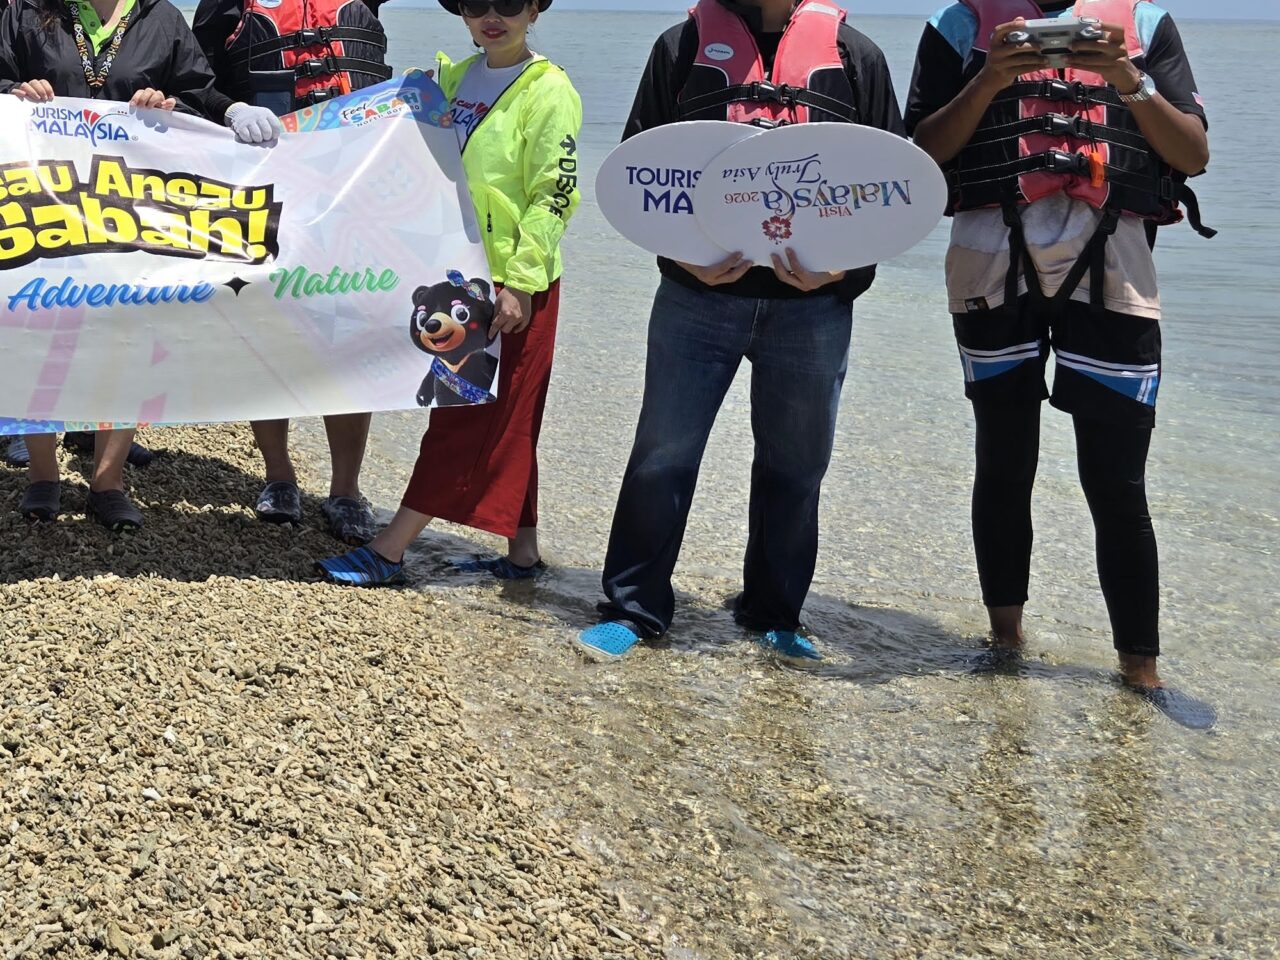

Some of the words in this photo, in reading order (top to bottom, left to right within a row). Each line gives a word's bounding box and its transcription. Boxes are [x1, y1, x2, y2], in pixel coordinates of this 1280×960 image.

[31, 106, 82, 122] URISM
[351, 92, 419, 124] SABAH
[31, 116, 129, 146] MALAYSIA
[722, 166, 762, 181] Asia
[765, 153, 822, 184] Truly
[95, 160, 266, 210] Ansau
[724, 193, 760, 205] 2026
[761, 179, 912, 213] Malaysia
[643, 189, 694, 215] MA
[818, 205, 853, 218] VISIT
[269, 264, 400, 300] Nature
